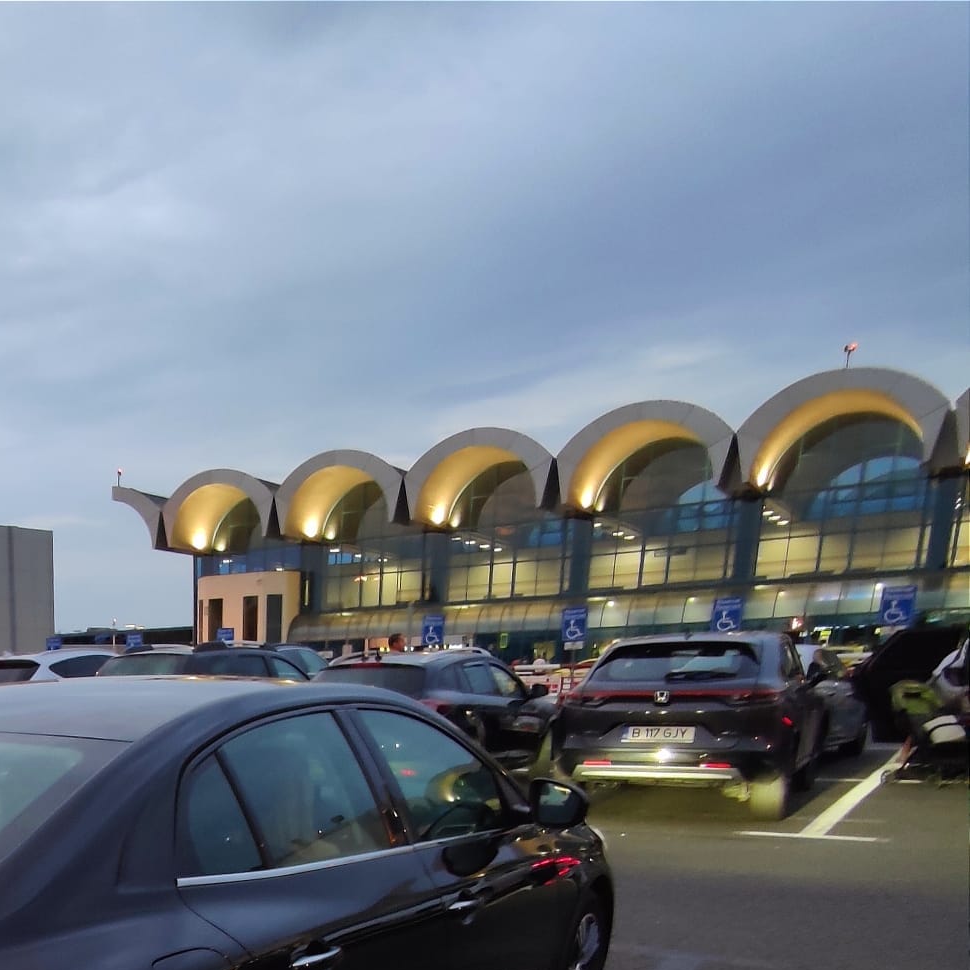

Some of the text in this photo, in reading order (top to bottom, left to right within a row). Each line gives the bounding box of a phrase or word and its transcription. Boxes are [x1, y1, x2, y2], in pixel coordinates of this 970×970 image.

[631, 727, 688, 738] B 117 GJY
